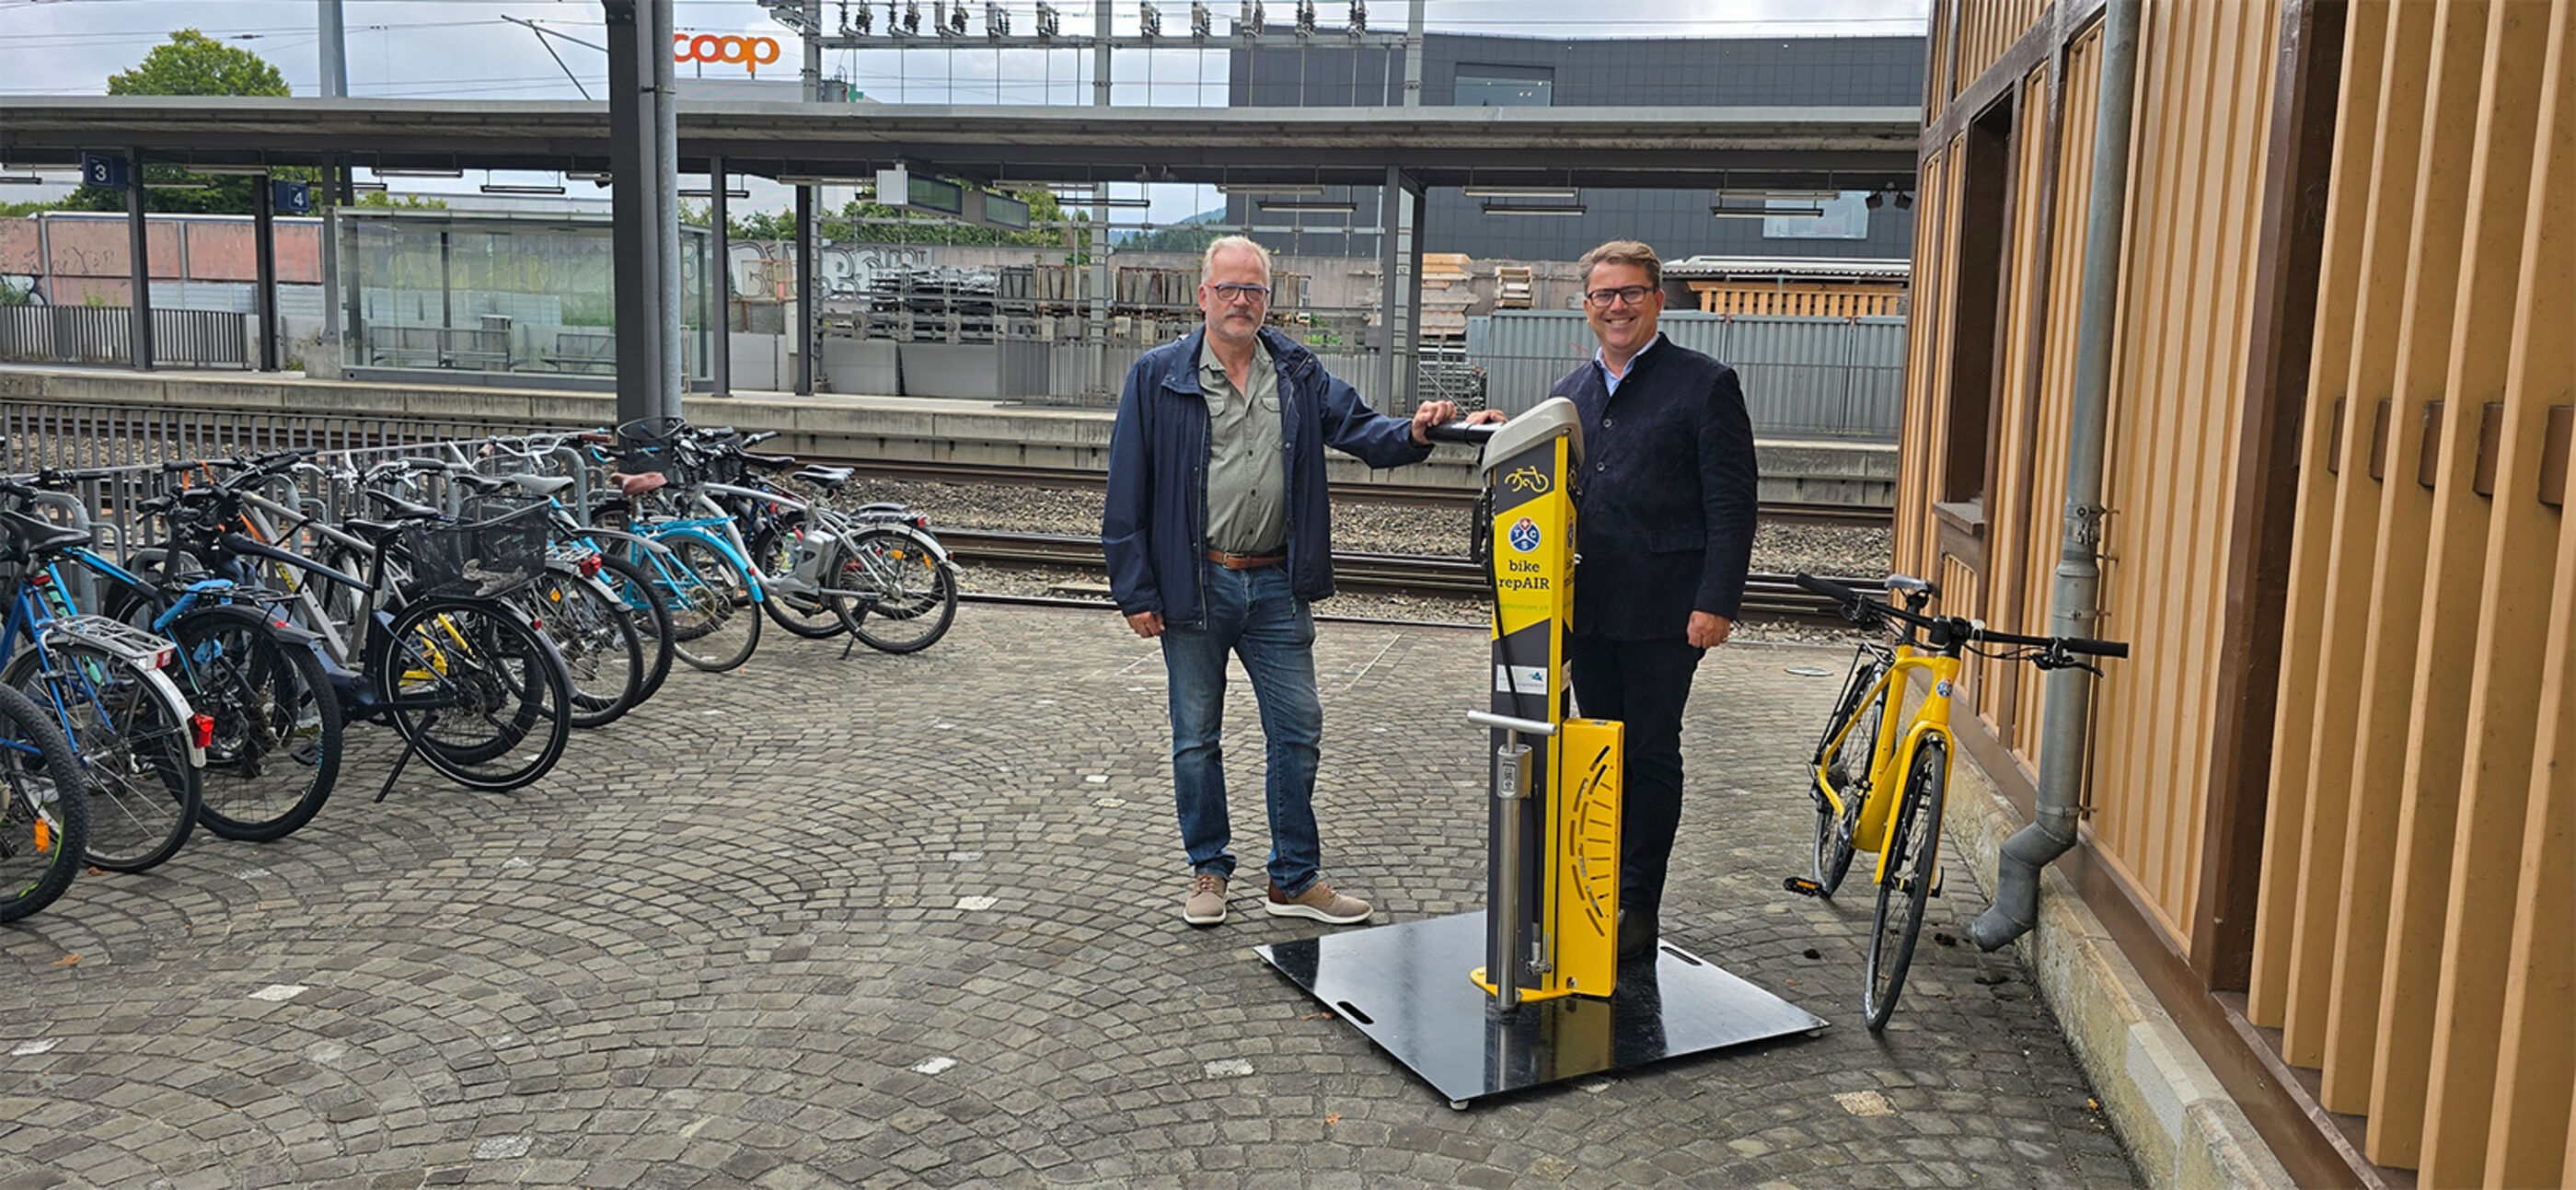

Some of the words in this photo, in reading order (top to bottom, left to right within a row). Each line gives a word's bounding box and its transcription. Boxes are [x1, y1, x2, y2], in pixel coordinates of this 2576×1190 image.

[674, 34, 780, 72] coop
[95, 164, 107, 181] 3
[294, 191, 304, 206] 4
[1508, 560, 1541, 572] bike
[1498, 577, 1550, 591] repAIR
